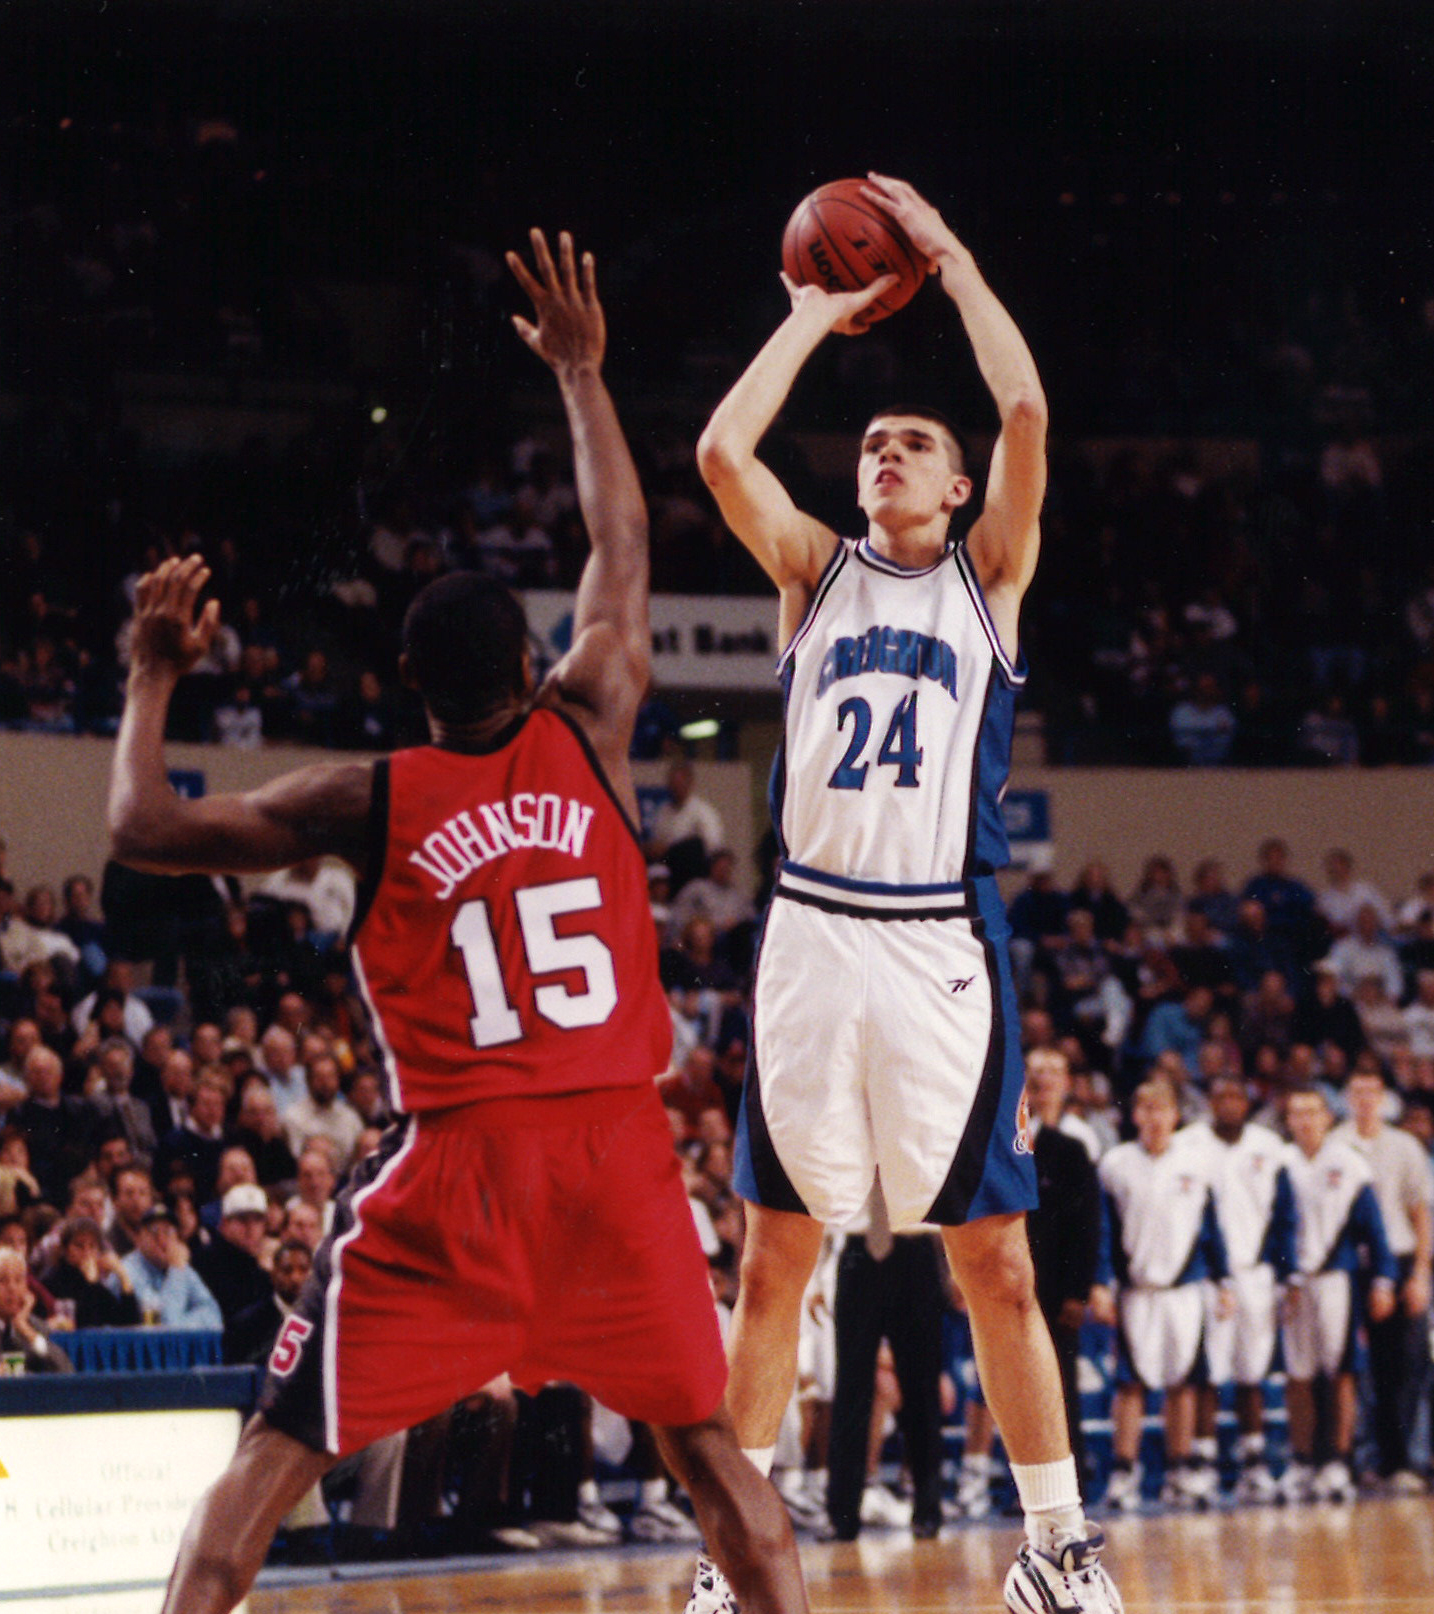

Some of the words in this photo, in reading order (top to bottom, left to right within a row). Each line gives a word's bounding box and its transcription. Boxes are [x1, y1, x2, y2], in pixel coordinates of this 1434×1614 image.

[827, 690, 924, 791] 24
[408, 792, 594, 899] JOHNSON
[450, 876, 619, 1050] 15
